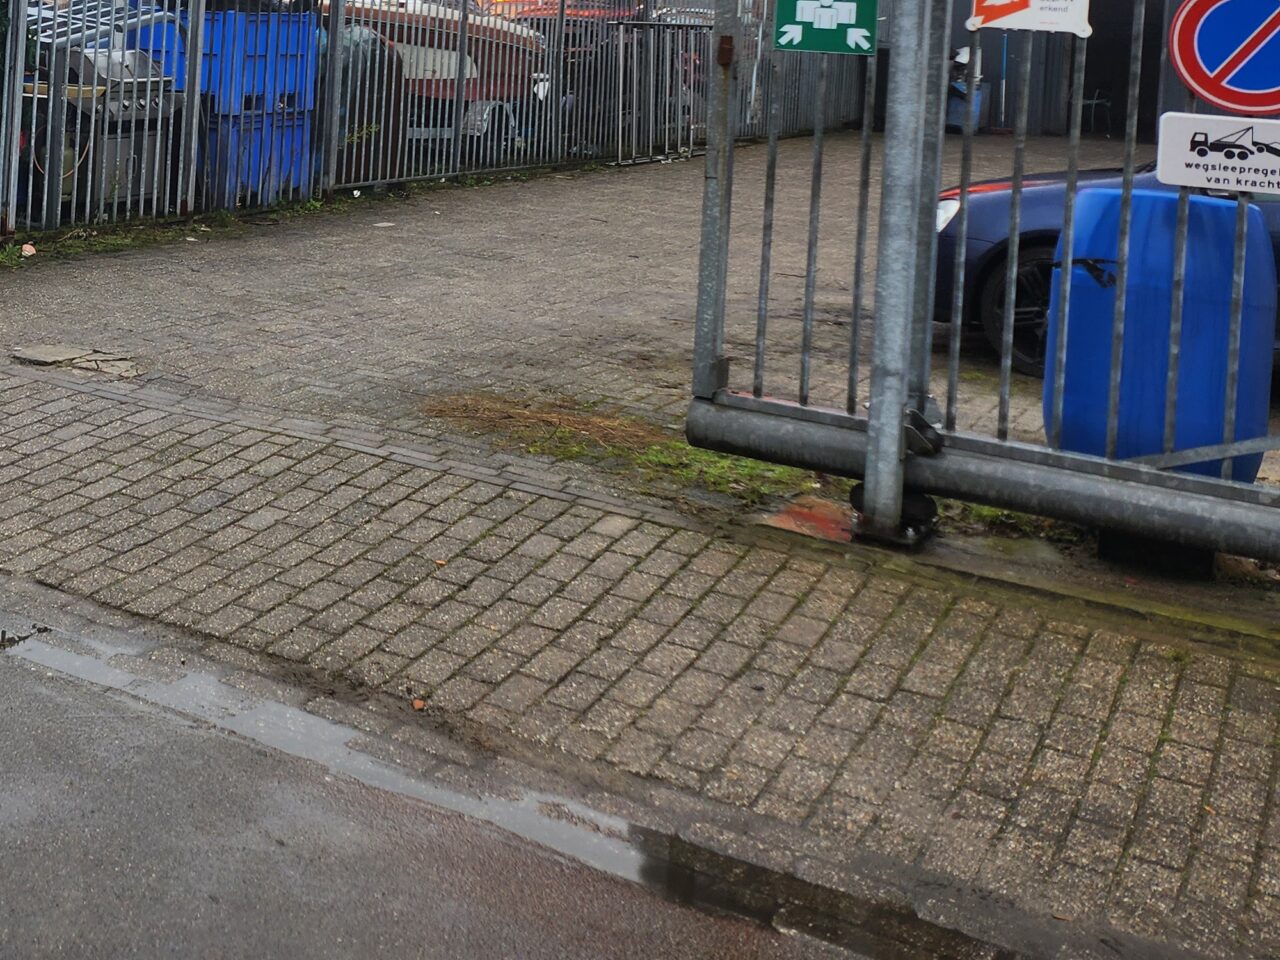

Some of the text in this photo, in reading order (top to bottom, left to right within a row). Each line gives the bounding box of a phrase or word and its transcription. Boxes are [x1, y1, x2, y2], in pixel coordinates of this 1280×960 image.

[1039, 4, 1069, 13] erkend
[1206, 176, 1280, 189] van kracht
